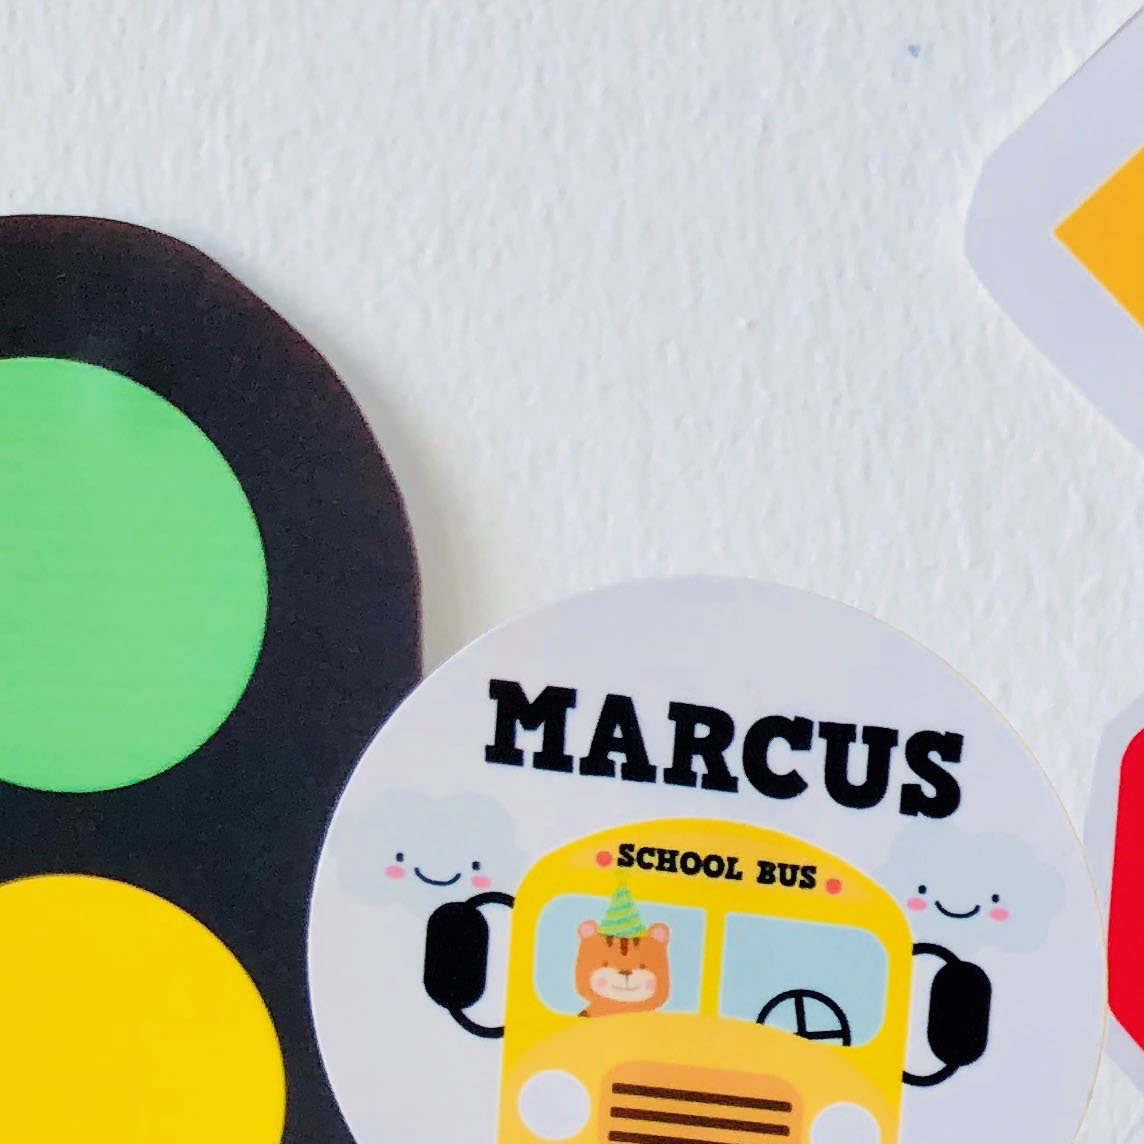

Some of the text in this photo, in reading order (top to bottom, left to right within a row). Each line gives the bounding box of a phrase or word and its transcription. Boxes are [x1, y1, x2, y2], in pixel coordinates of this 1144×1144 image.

[485, 678, 964, 820] MARCUS
[617, 843, 817, 890] SCHOOL BUS
